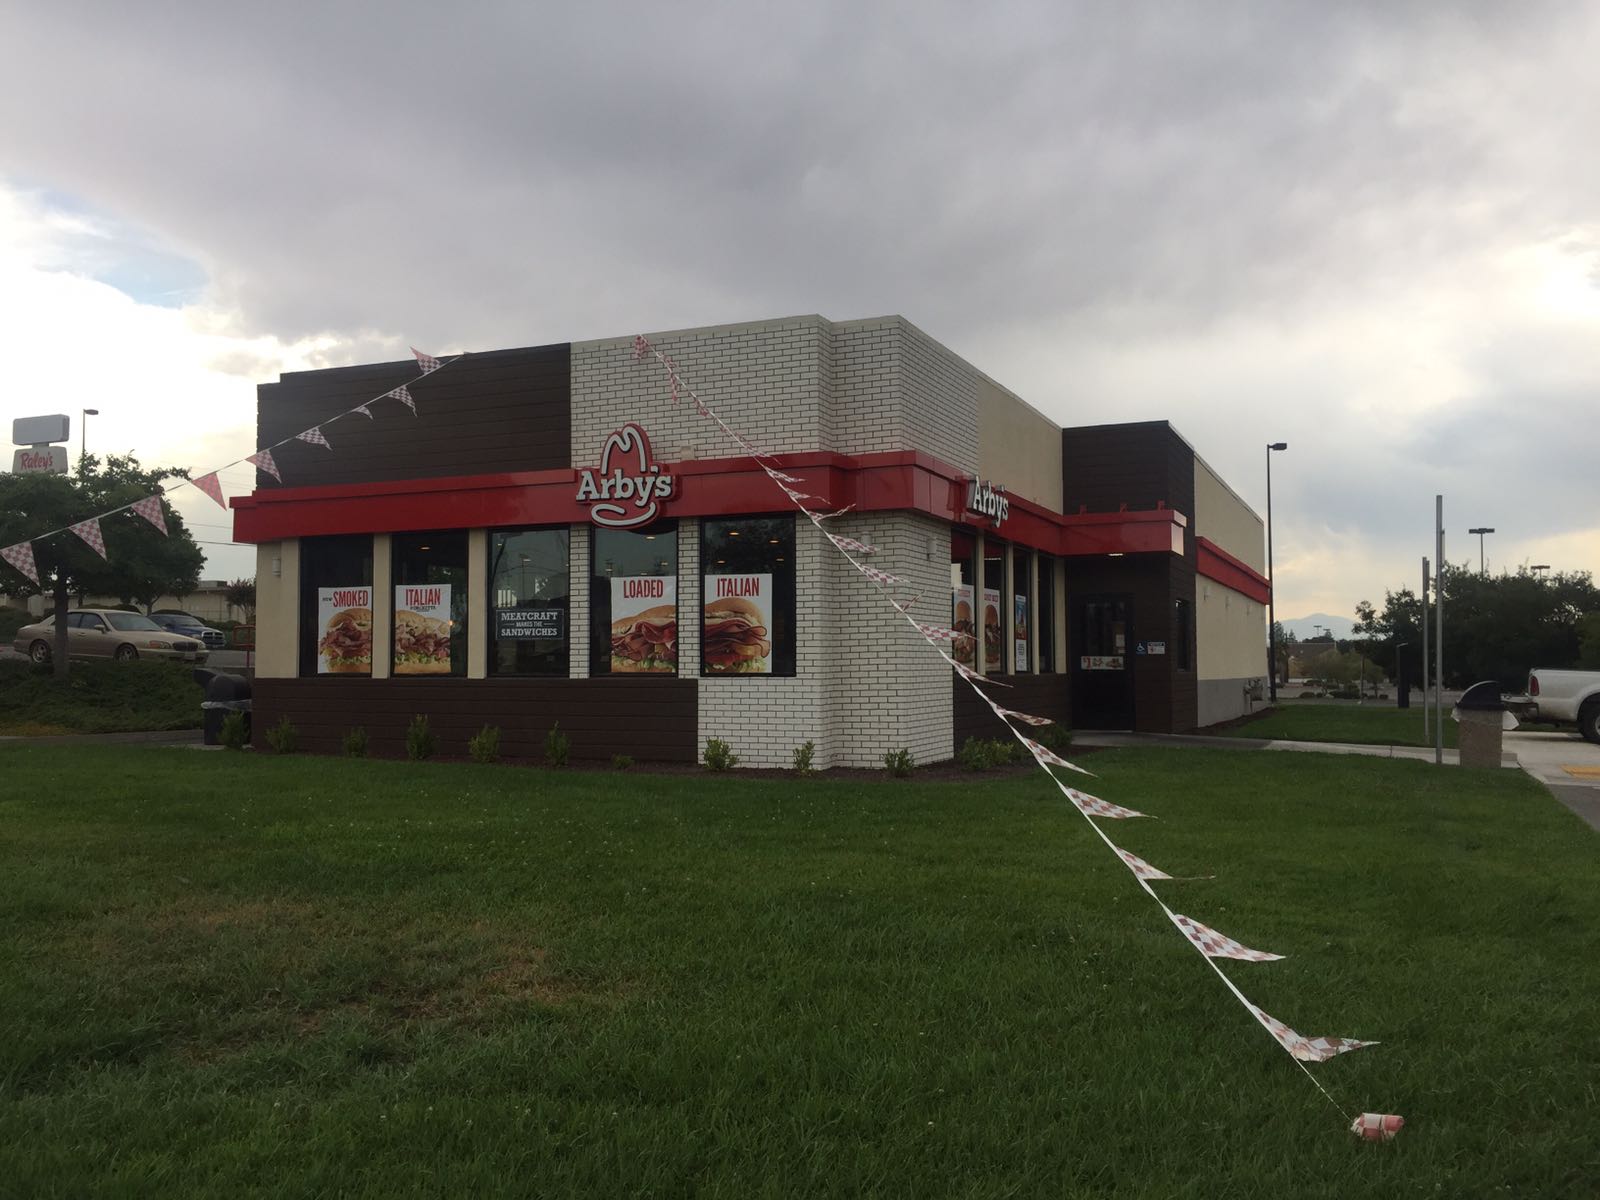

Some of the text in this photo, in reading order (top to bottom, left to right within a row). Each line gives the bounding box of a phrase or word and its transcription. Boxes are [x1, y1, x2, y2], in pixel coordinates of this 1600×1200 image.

[20, 451, 53, 471] Raley's
[575, 465, 672, 508] Arby's
[973, 475, 1009, 528] Arby's
[405, 588, 441, 605] ITALIAN
[623, 579, 664, 599] LOADED
[716, 577, 760, 597] ITALIAN
[332, 590, 369, 607] SMOKED
[501, 611, 558, 621] MEATCRAFT
[501, 628, 558, 636] SANDWICHES
